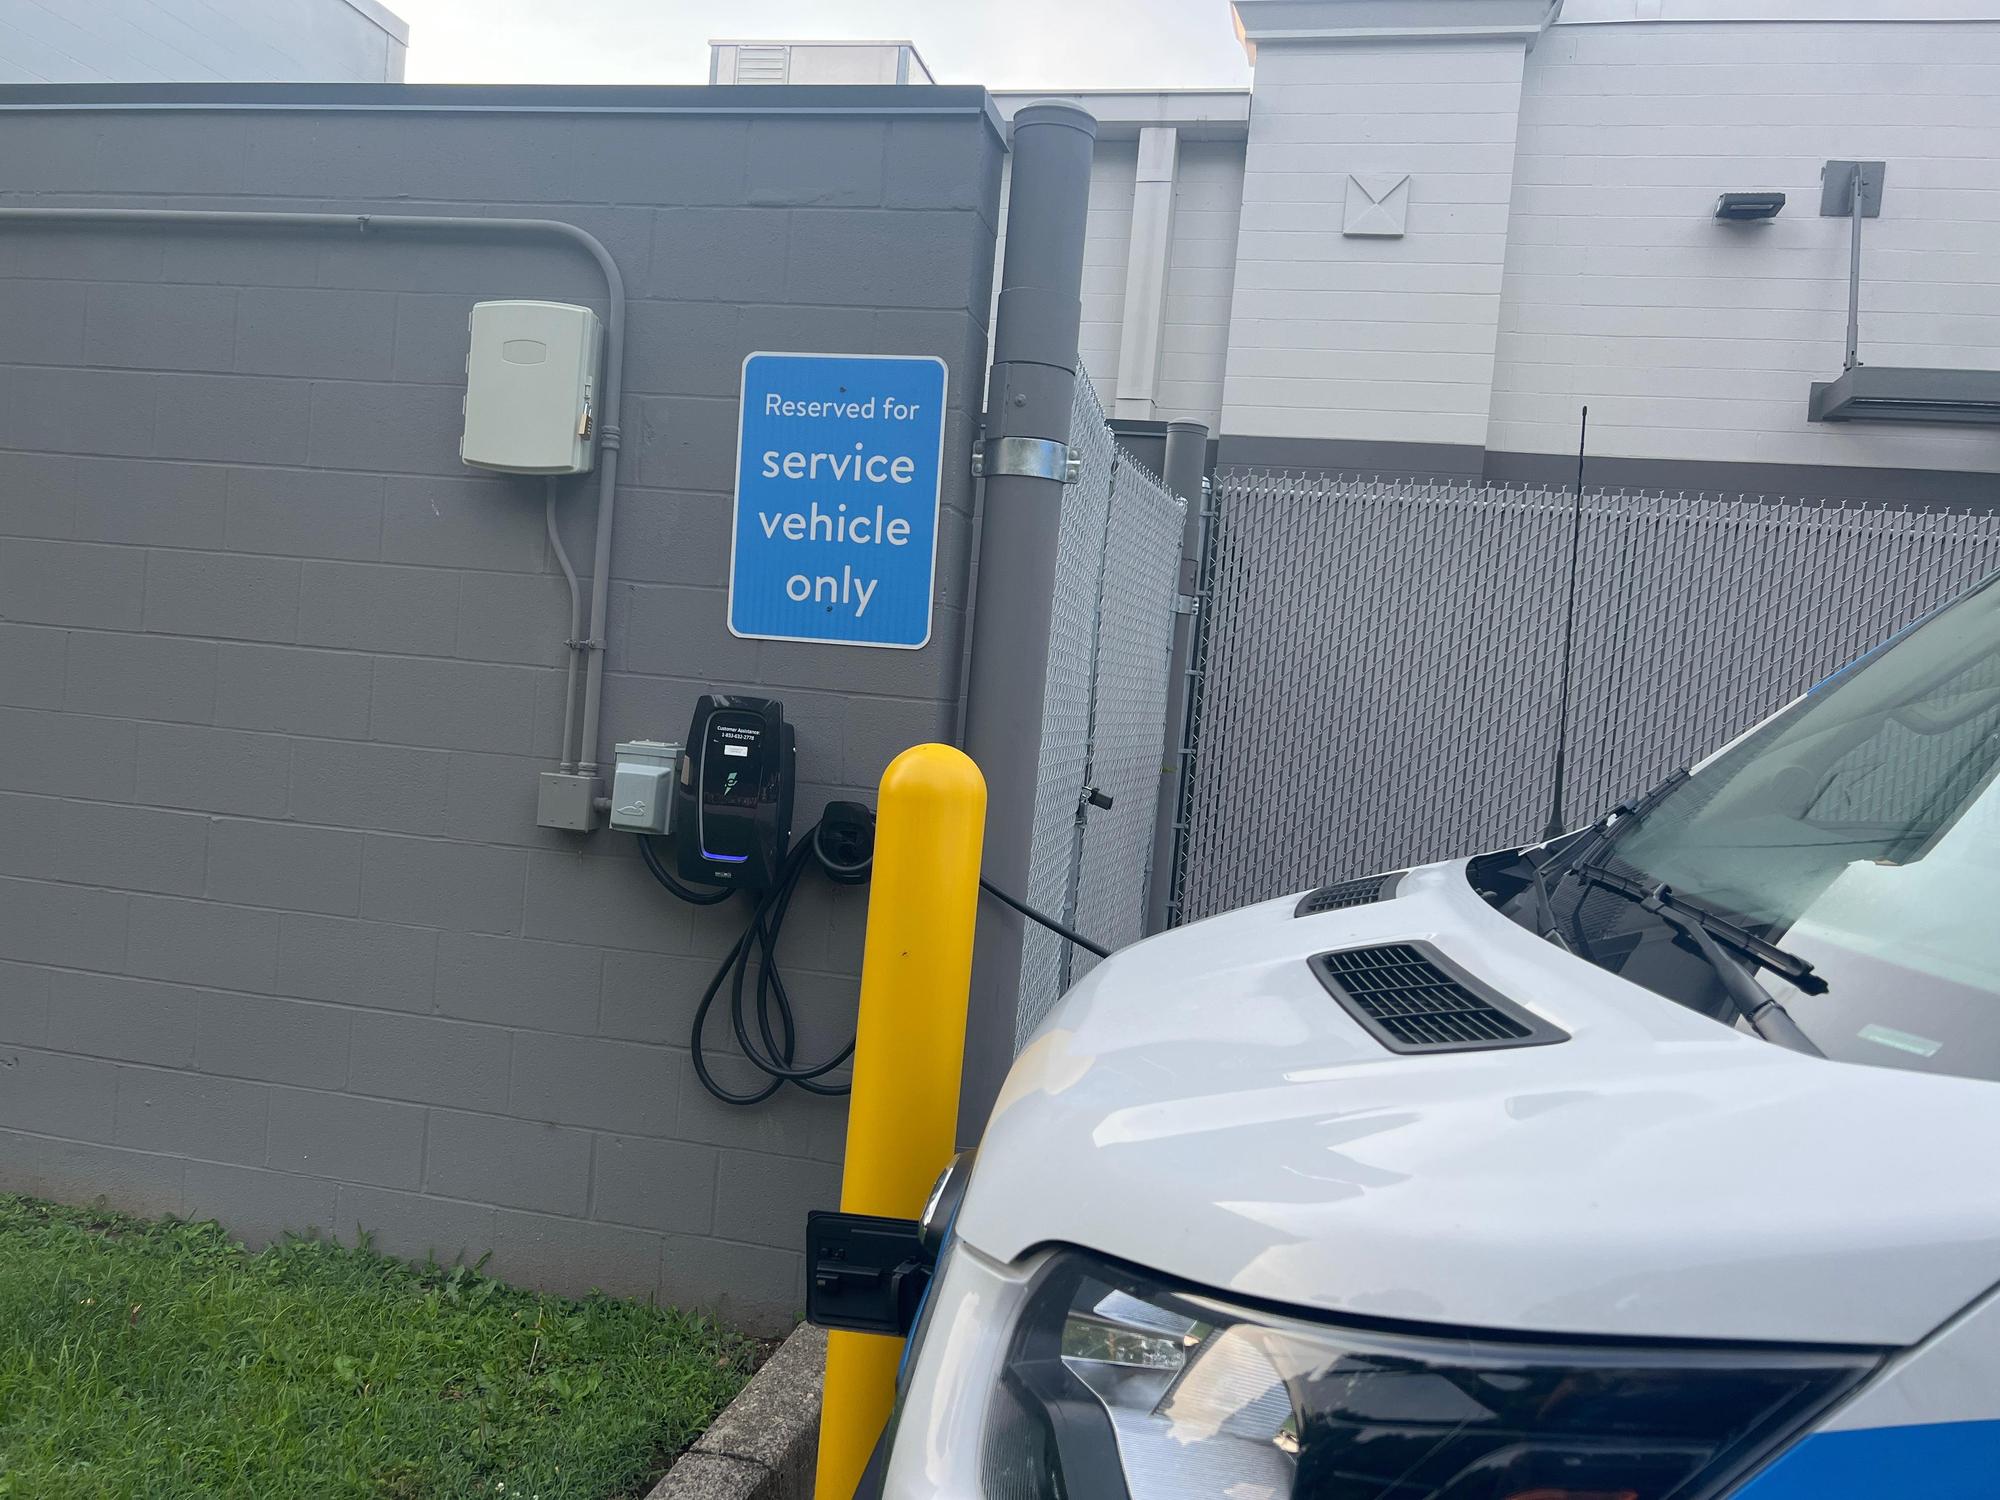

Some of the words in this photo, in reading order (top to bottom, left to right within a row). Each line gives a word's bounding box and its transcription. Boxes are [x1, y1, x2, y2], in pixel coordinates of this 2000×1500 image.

[765, 393, 875, 419] Reserved
[883, 397, 920, 421] for
[761, 441, 915, 484] service
[758, 502, 912, 546] vehicle
[786, 565, 878, 618] only
